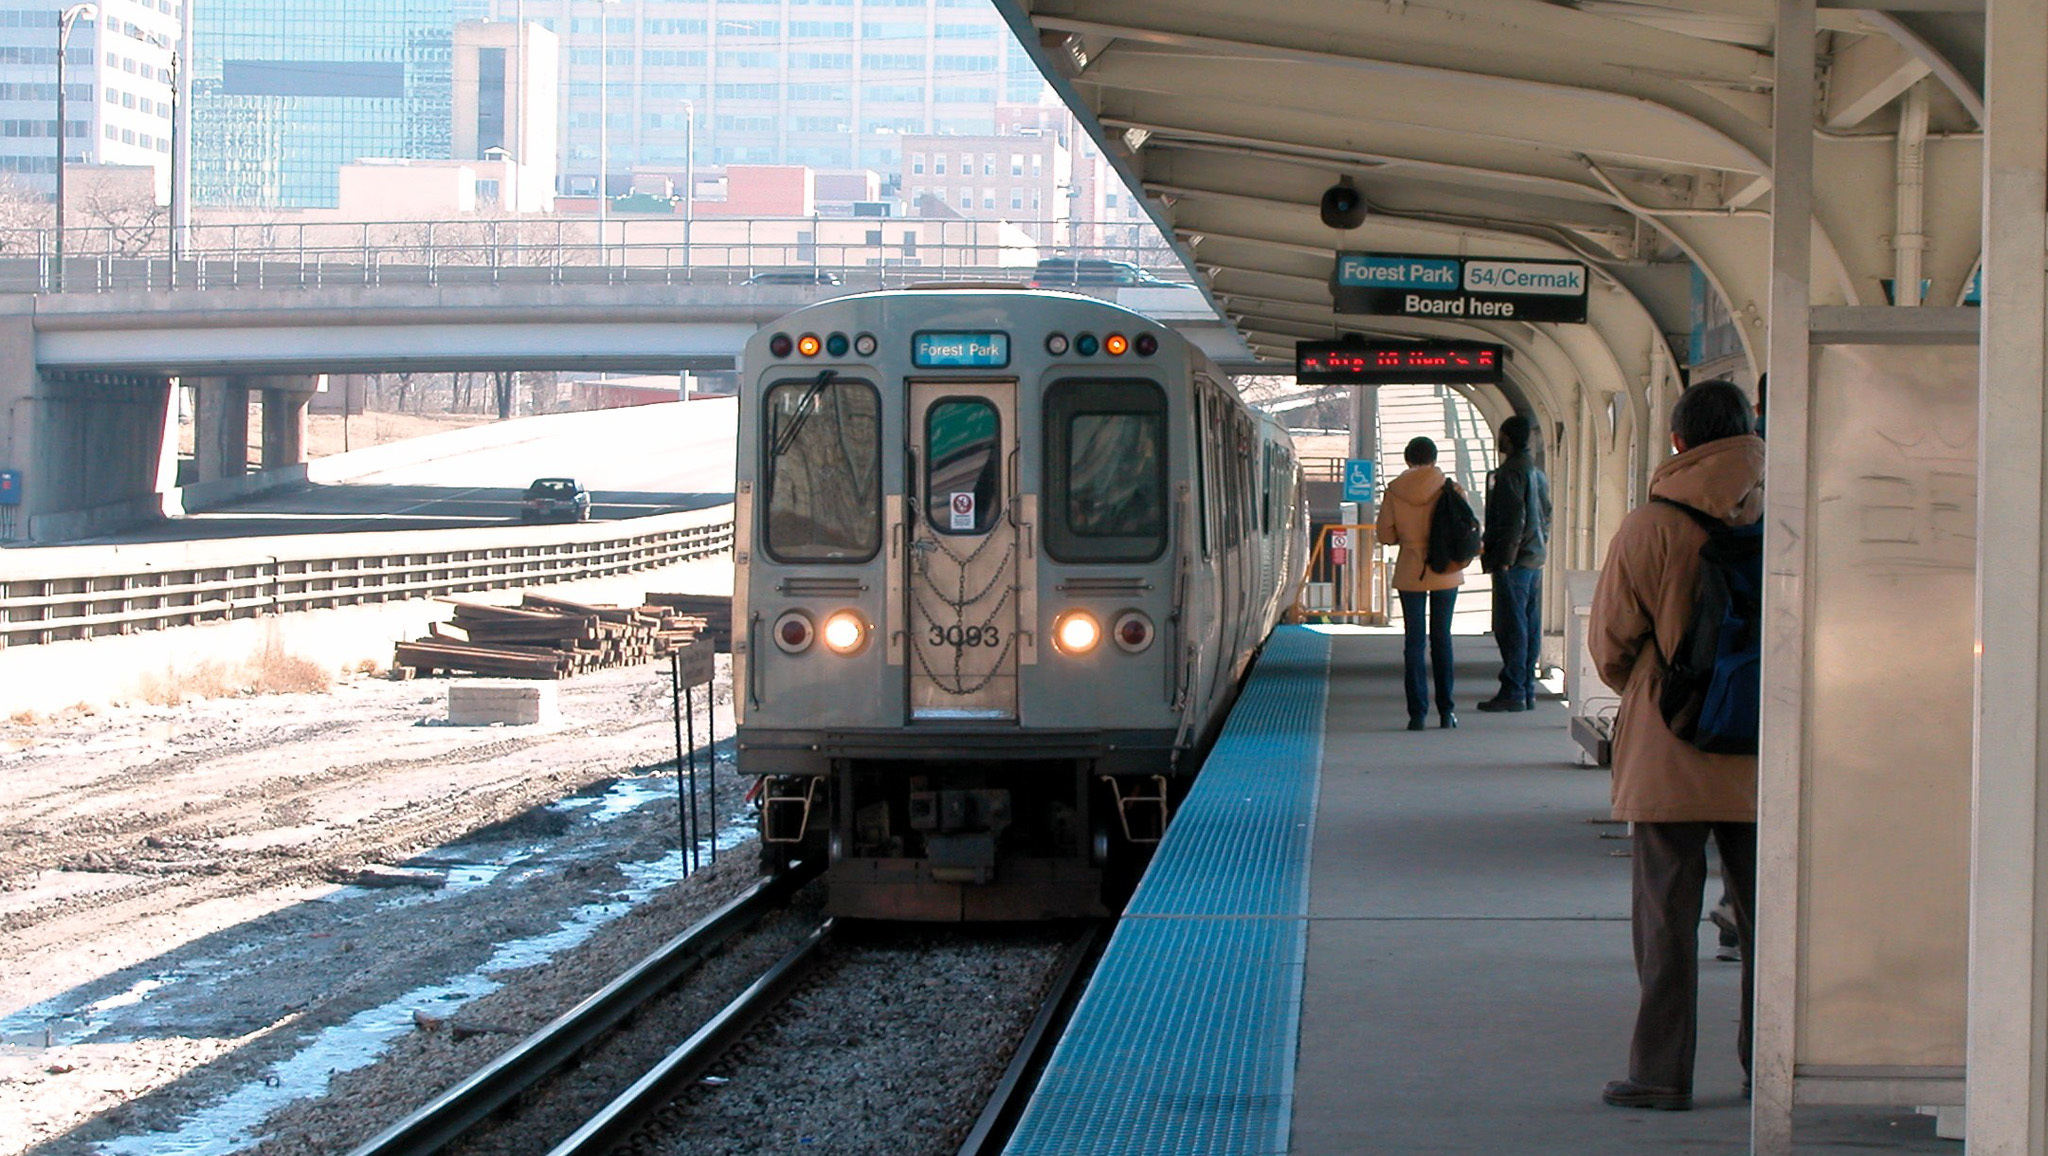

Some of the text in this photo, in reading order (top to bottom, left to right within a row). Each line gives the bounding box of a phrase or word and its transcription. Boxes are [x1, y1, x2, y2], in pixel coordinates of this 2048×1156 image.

[1344, 262, 1454, 284] Forest Park
[1470, 267, 1579, 289] 54/Cermak
[1405, 295, 1514, 317] Board here
[920, 343, 999, 356] Forest Park
[928, 625, 1000, 648] 3093
